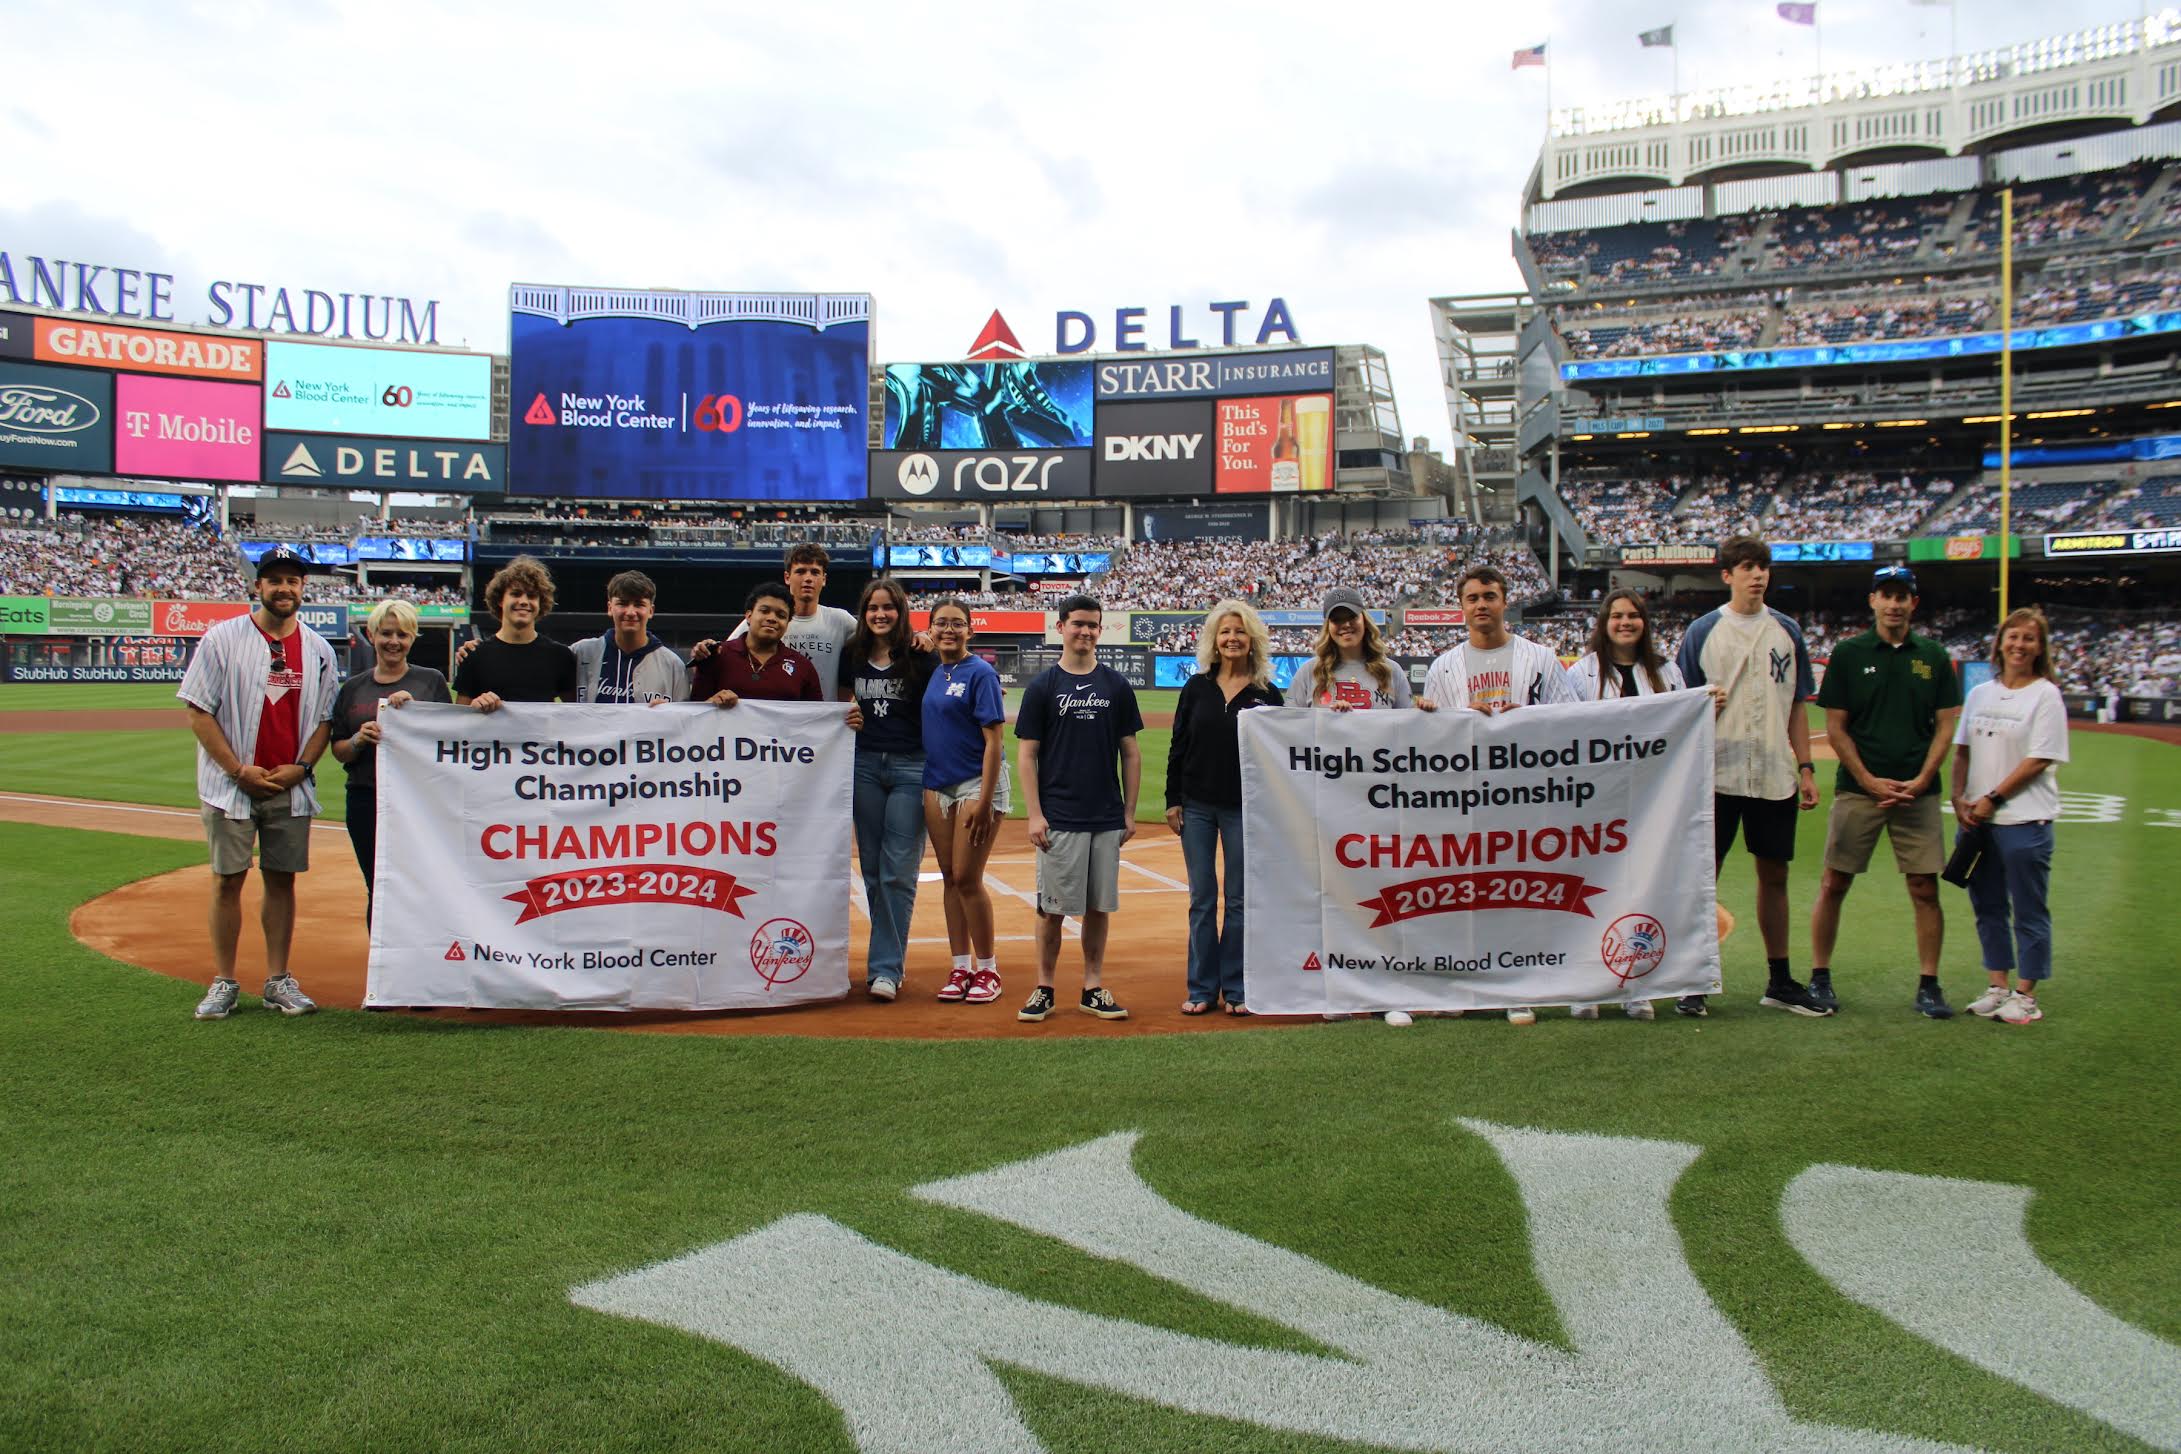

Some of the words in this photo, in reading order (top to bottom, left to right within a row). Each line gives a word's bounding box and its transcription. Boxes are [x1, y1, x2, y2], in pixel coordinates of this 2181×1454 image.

[0, 251, 174, 321] ANKEE
[208, 280, 440, 344] STADIUM
[1056, 298, 1302, 354] DELTA
[50, 327, 252, 372] GATORADE
[295, 380, 322, 392] New
[325, 382, 349, 393] York
[1100, 362, 1215, 394] STARR
[1224, 361, 1330, 381] INSURANCE
[0, 389, 77, 427] Ford
[295, 390, 328, 402] Blood
[332, 394, 369, 405] Center
[382, 385, 413, 408] 60
[561, 393, 604, 410] New
[606, 395, 645, 411] York
[747, 402, 770, 417] Years
[772, 404, 782, 415] of
[561, 410, 614, 427] Blood
[616, 412, 675, 429] Center
[694, 394, 742, 433] 60
[794, 418, 812, 429] and
[1222, 405, 1260, 420] This
[0, 434, 78, 448] uyFordNow.com
[158, 413, 253, 446] Mobile
[1222, 421, 1268, 436] Bud's
[1104, 433, 1204, 462] DKNY
[1222, 438, 1250, 454] For
[337, 447, 491, 481] DELTA
[953, 455, 1064, 492] razr
[1222, 455, 1258, 470] You.
[1622, 547, 1655, 560] Parts
[1656, 545, 1716, 560] Authority
[2052, 535, 2126, 551] ARMITRON
[0, 607, 44, 624] Eats
[297, 609, 337, 628] oupa
[1408, 613, 1440, 621] Reebok
[789, 641, 832, 653] NKEES
[14, 667, 68, 680] StubHub
[72, 667, 127, 680] StubHub
[132, 668, 186, 680] StubHub
[1769, 646, 1792, 683] NY
[873, 699, 889, 717] NY
[1056, 692, 1110, 716] Yankees
[436, 740, 512, 770] High
[520, 740, 626, 767] School
[636, 737, 725, 765] Blood
[734, 736, 815, 765] Drive
[1289, 747, 1364, 779] High
[1373, 745, 1479, 773] School
[1489, 739, 1579, 770] Blood
[1588, 735, 1667, 764] Drive
[514, 772, 742, 808] Championship
[1368, 776, 1595, 814] Championship
[480, 820, 778, 860] CHAMPIONS
[1335, 818, 1628, 869] CHAMPIONS
[542, 871, 717, 908] 2023-2024
[1395, 878, 1566, 914] 2023-2024
[474, 943, 521, 965] New
[526, 952, 575, 971] York
[582, 950, 643, 970] Blood
[649, 948, 717, 967] Center
[750, 938, 813, 972] Yankees
[1328, 951, 1376, 971] New
[1381, 955, 1426, 972] York
[1434, 952, 1492, 972] Blood
[1498, 950, 1566, 969] Center
[1602, 939, 1665, 967] Yankees
